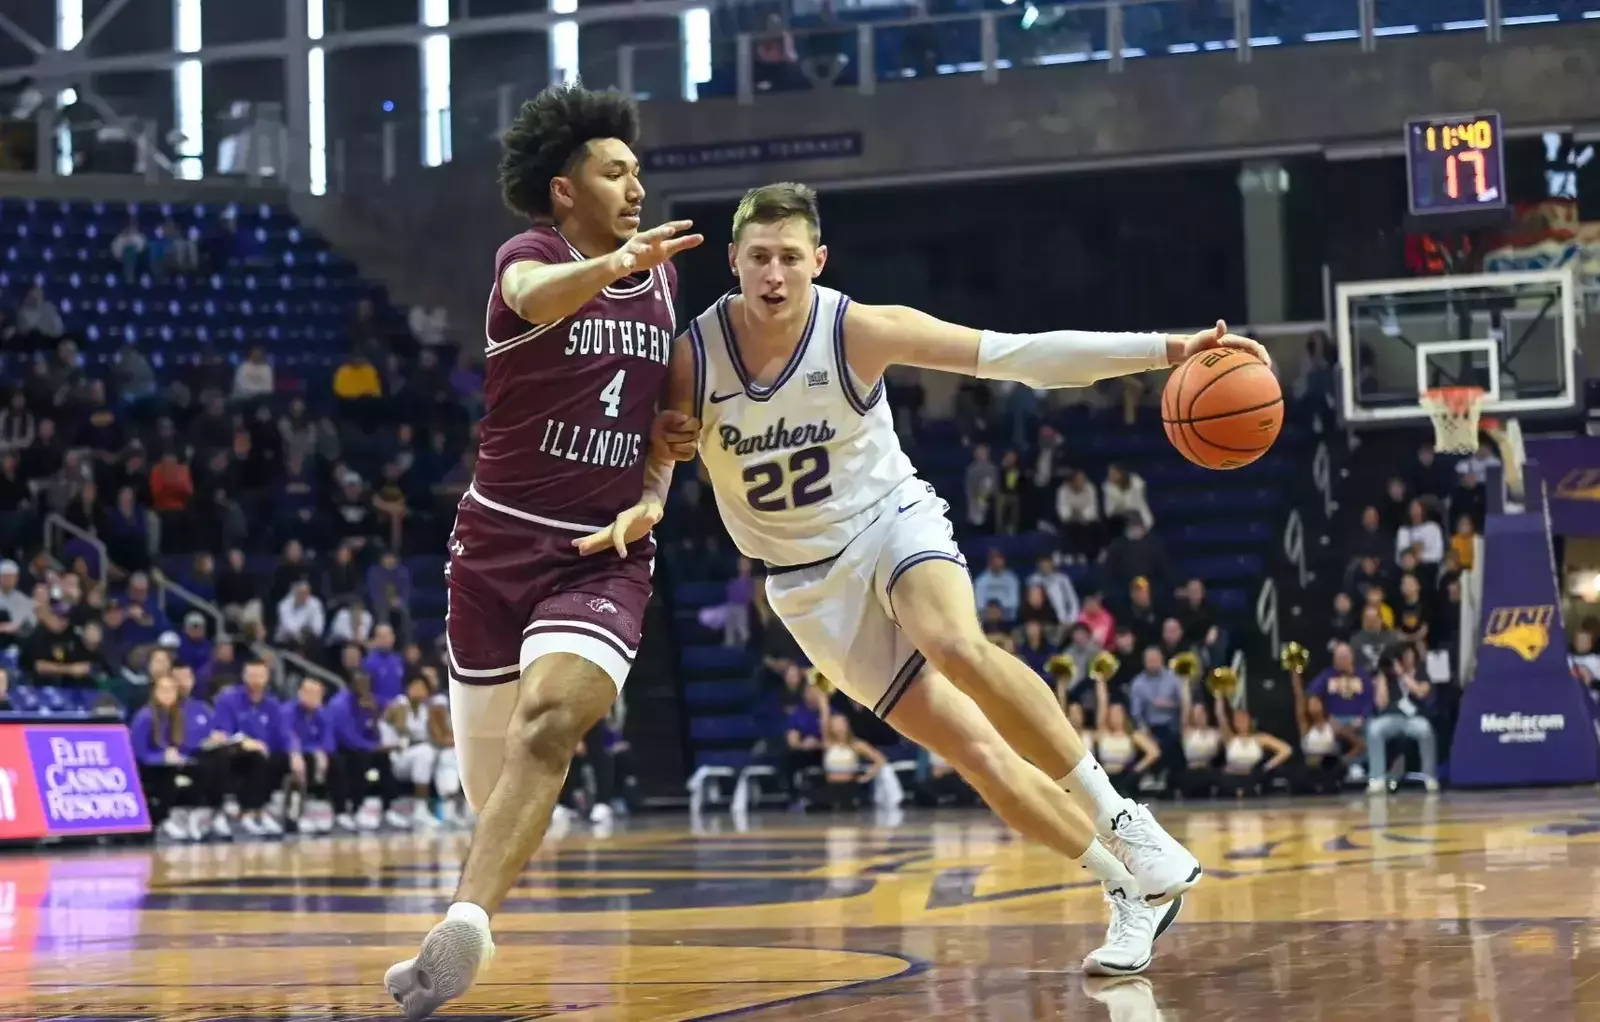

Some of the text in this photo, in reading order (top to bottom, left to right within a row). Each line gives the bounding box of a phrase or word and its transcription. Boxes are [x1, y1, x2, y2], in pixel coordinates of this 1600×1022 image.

[1426, 120, 1492, 151] 11:40
[1446, 150, 1486, 199] 17
[564, 318, 671, 367] SOUTHERN
[599, 369, 626, 418] 4
[539, 418, 642, 468] ILLINOIS
[719, 417, 836, 456] Panthers
[742, 445, 833, 512] 22
[1486, 604, 1555, 634] UNI
[1480, 711, 1564, 733] Mediacom
[49, 737, 111, 767] ELITE
[45, 763, 127, 793] CASINO
[46, 789, 139, 822] RESORTS
